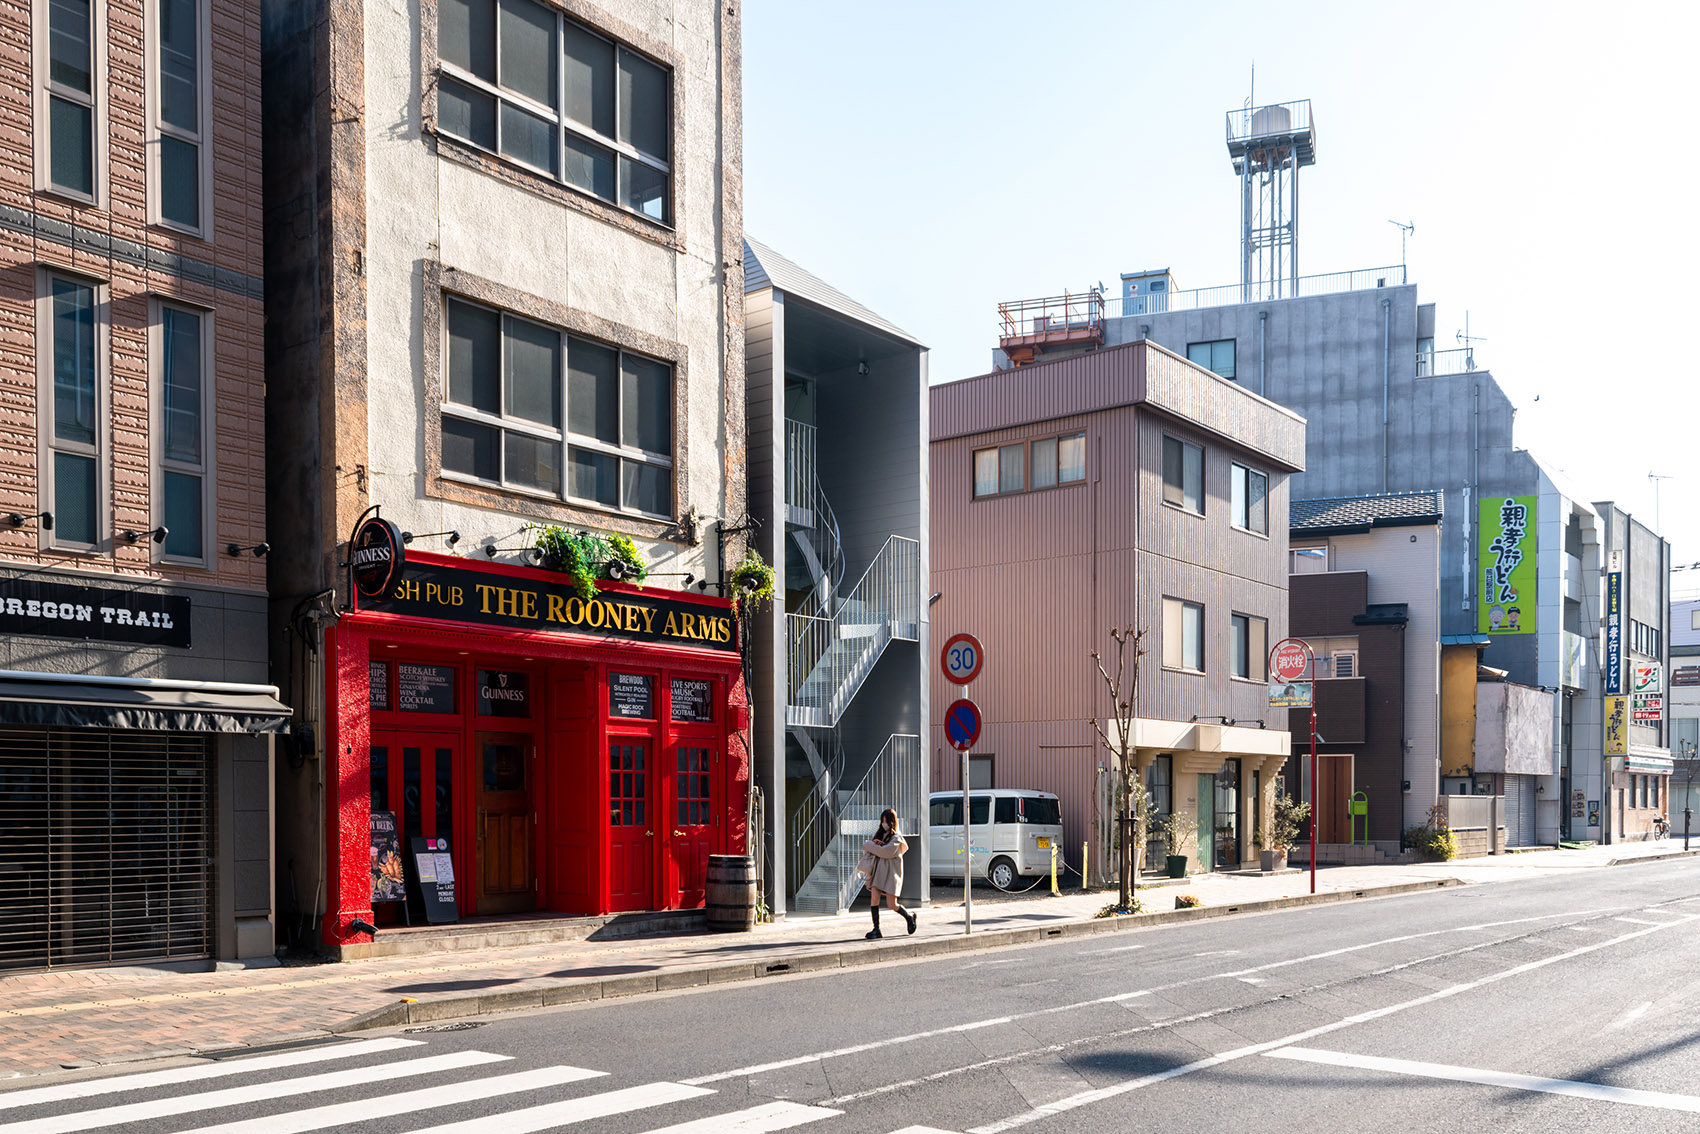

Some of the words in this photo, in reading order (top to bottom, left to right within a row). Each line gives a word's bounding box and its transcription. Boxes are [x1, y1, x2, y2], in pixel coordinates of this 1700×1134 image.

[353, 546, 391, 566] GUINNESS
[100, 606, 174, 629] TRAIL
[426, 582, 464, 606] PUB
[475, 584, 539, 620] THE
[546, 594, 658, 634] ROONEY
[662, 611, 731, 643] ARMS
[950, 648, 974, 671] 30
[1608, 614, 1618, 688] 親孝行うどん
[1279, 654, 1304, 669] 消火栓
[399, 666, 437, 676] BEER&ALE
[481, 685, 524, 701] GUINNESS
[684, 681, 707, 690] SPORTS
[400, 696, 434, 705] COCKTAIL
